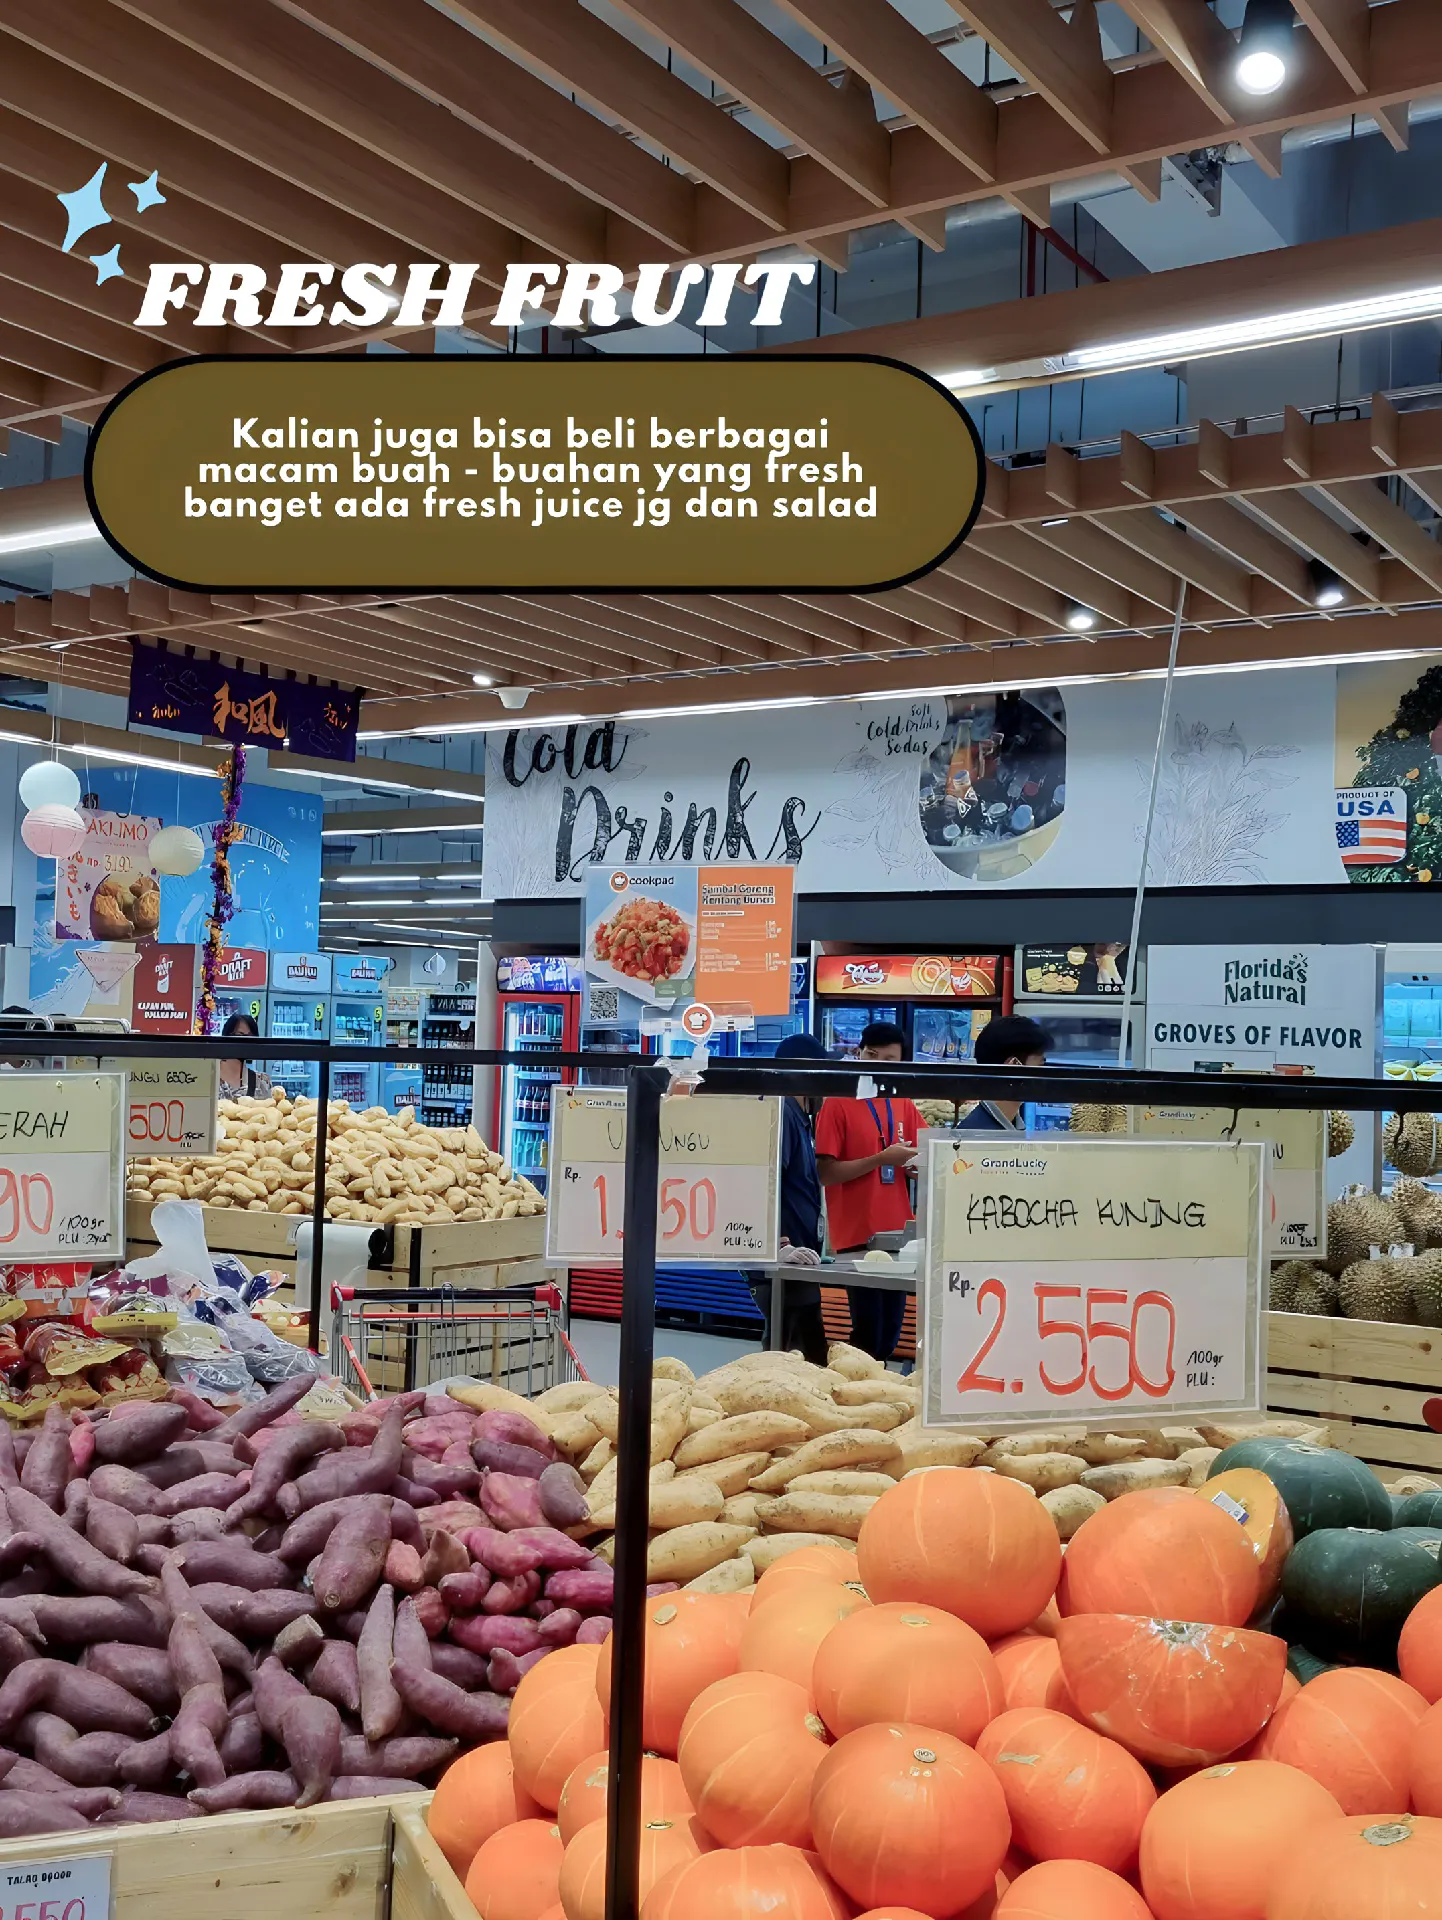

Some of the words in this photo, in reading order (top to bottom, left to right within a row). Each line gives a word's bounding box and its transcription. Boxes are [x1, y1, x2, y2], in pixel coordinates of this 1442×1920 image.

[212, 681, 286, 739] 和風
[503, 721, 629, 787] Cold
[885, 735, 929, 756] Sodas
[555, 757, 822, 883] Drinks
[1337, 800, 1395, 817] USA
[629, 876, 674, 887] cookpad
[1224, 980, 1306, 1006] Natural
[1154, 1022, 1236, 1045] GROVES
[1244, 1025, 1271, 1045] OF
[1280, 1026, 1362, 1049] FLAVOR
[966, 1193, 1079, 1234] KABOCHA
[1096, 1198, 1207, 1228] KUNING
[956, 1278, 1176, 1401] 2.550
